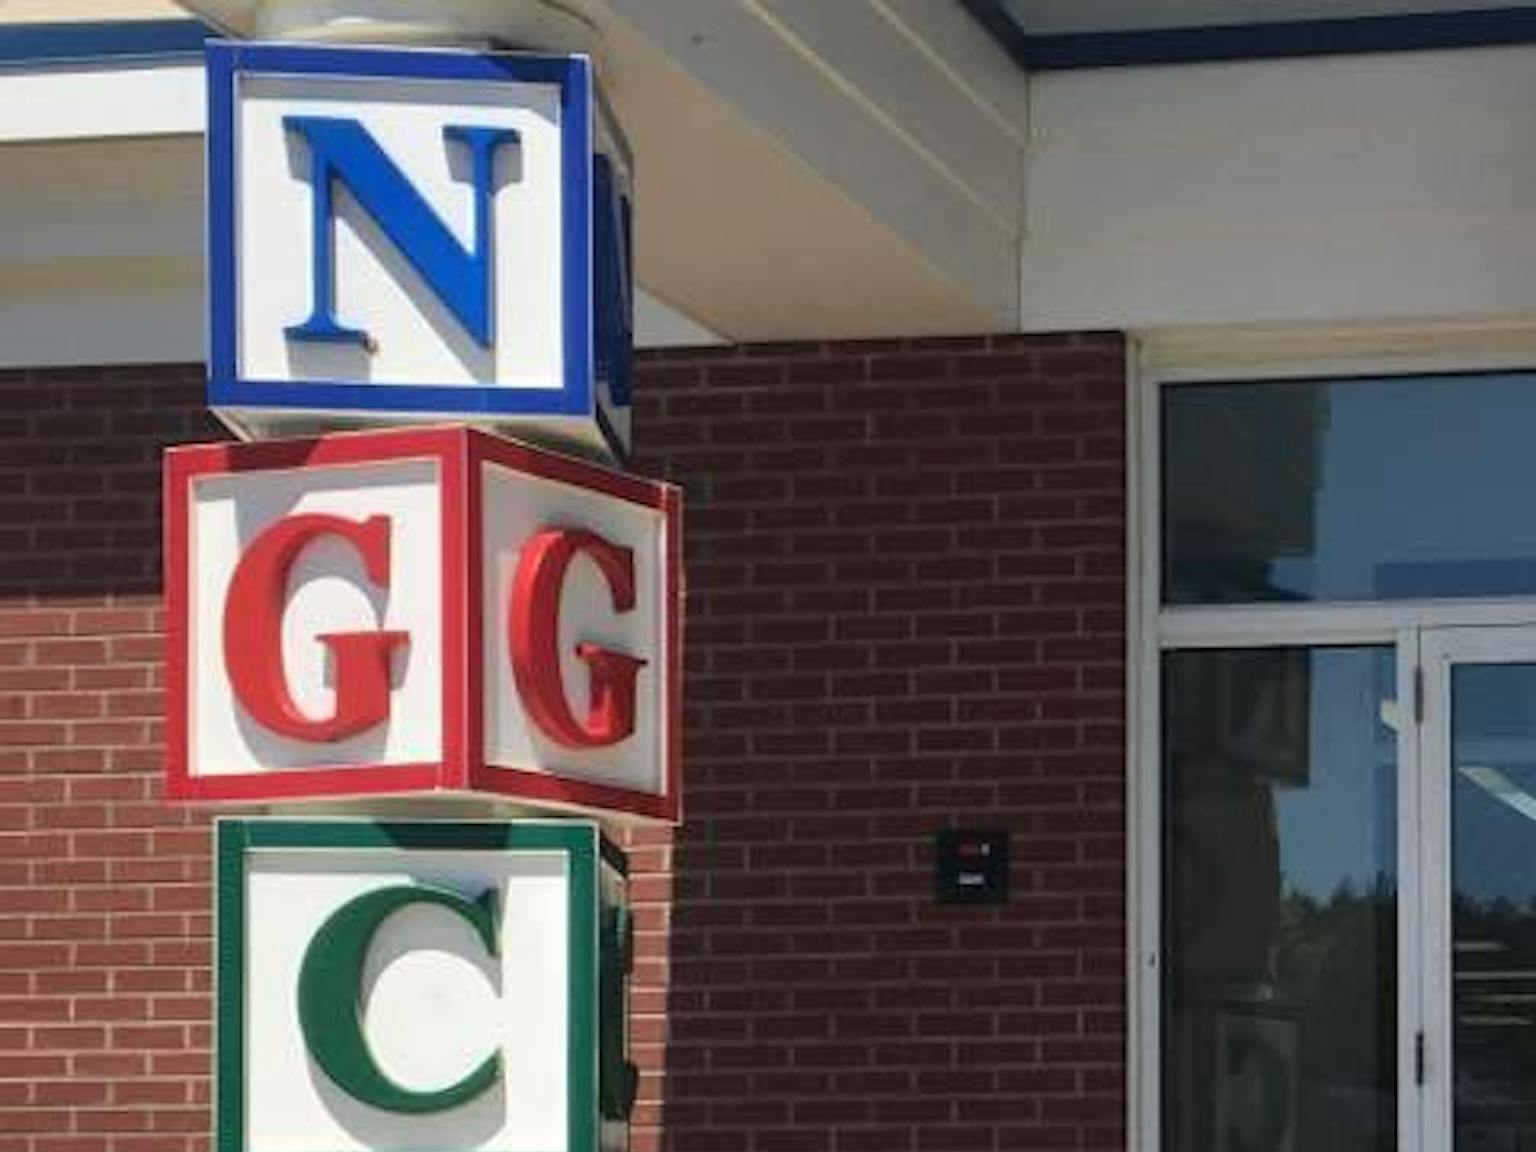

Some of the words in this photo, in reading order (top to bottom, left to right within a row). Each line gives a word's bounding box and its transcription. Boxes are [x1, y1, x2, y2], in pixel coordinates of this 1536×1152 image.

[282, 115, 521, 349] N
[224, 512, 411, 744] G
[509, 528, 648, 748] G
[298, 886, 502, 1116] C
